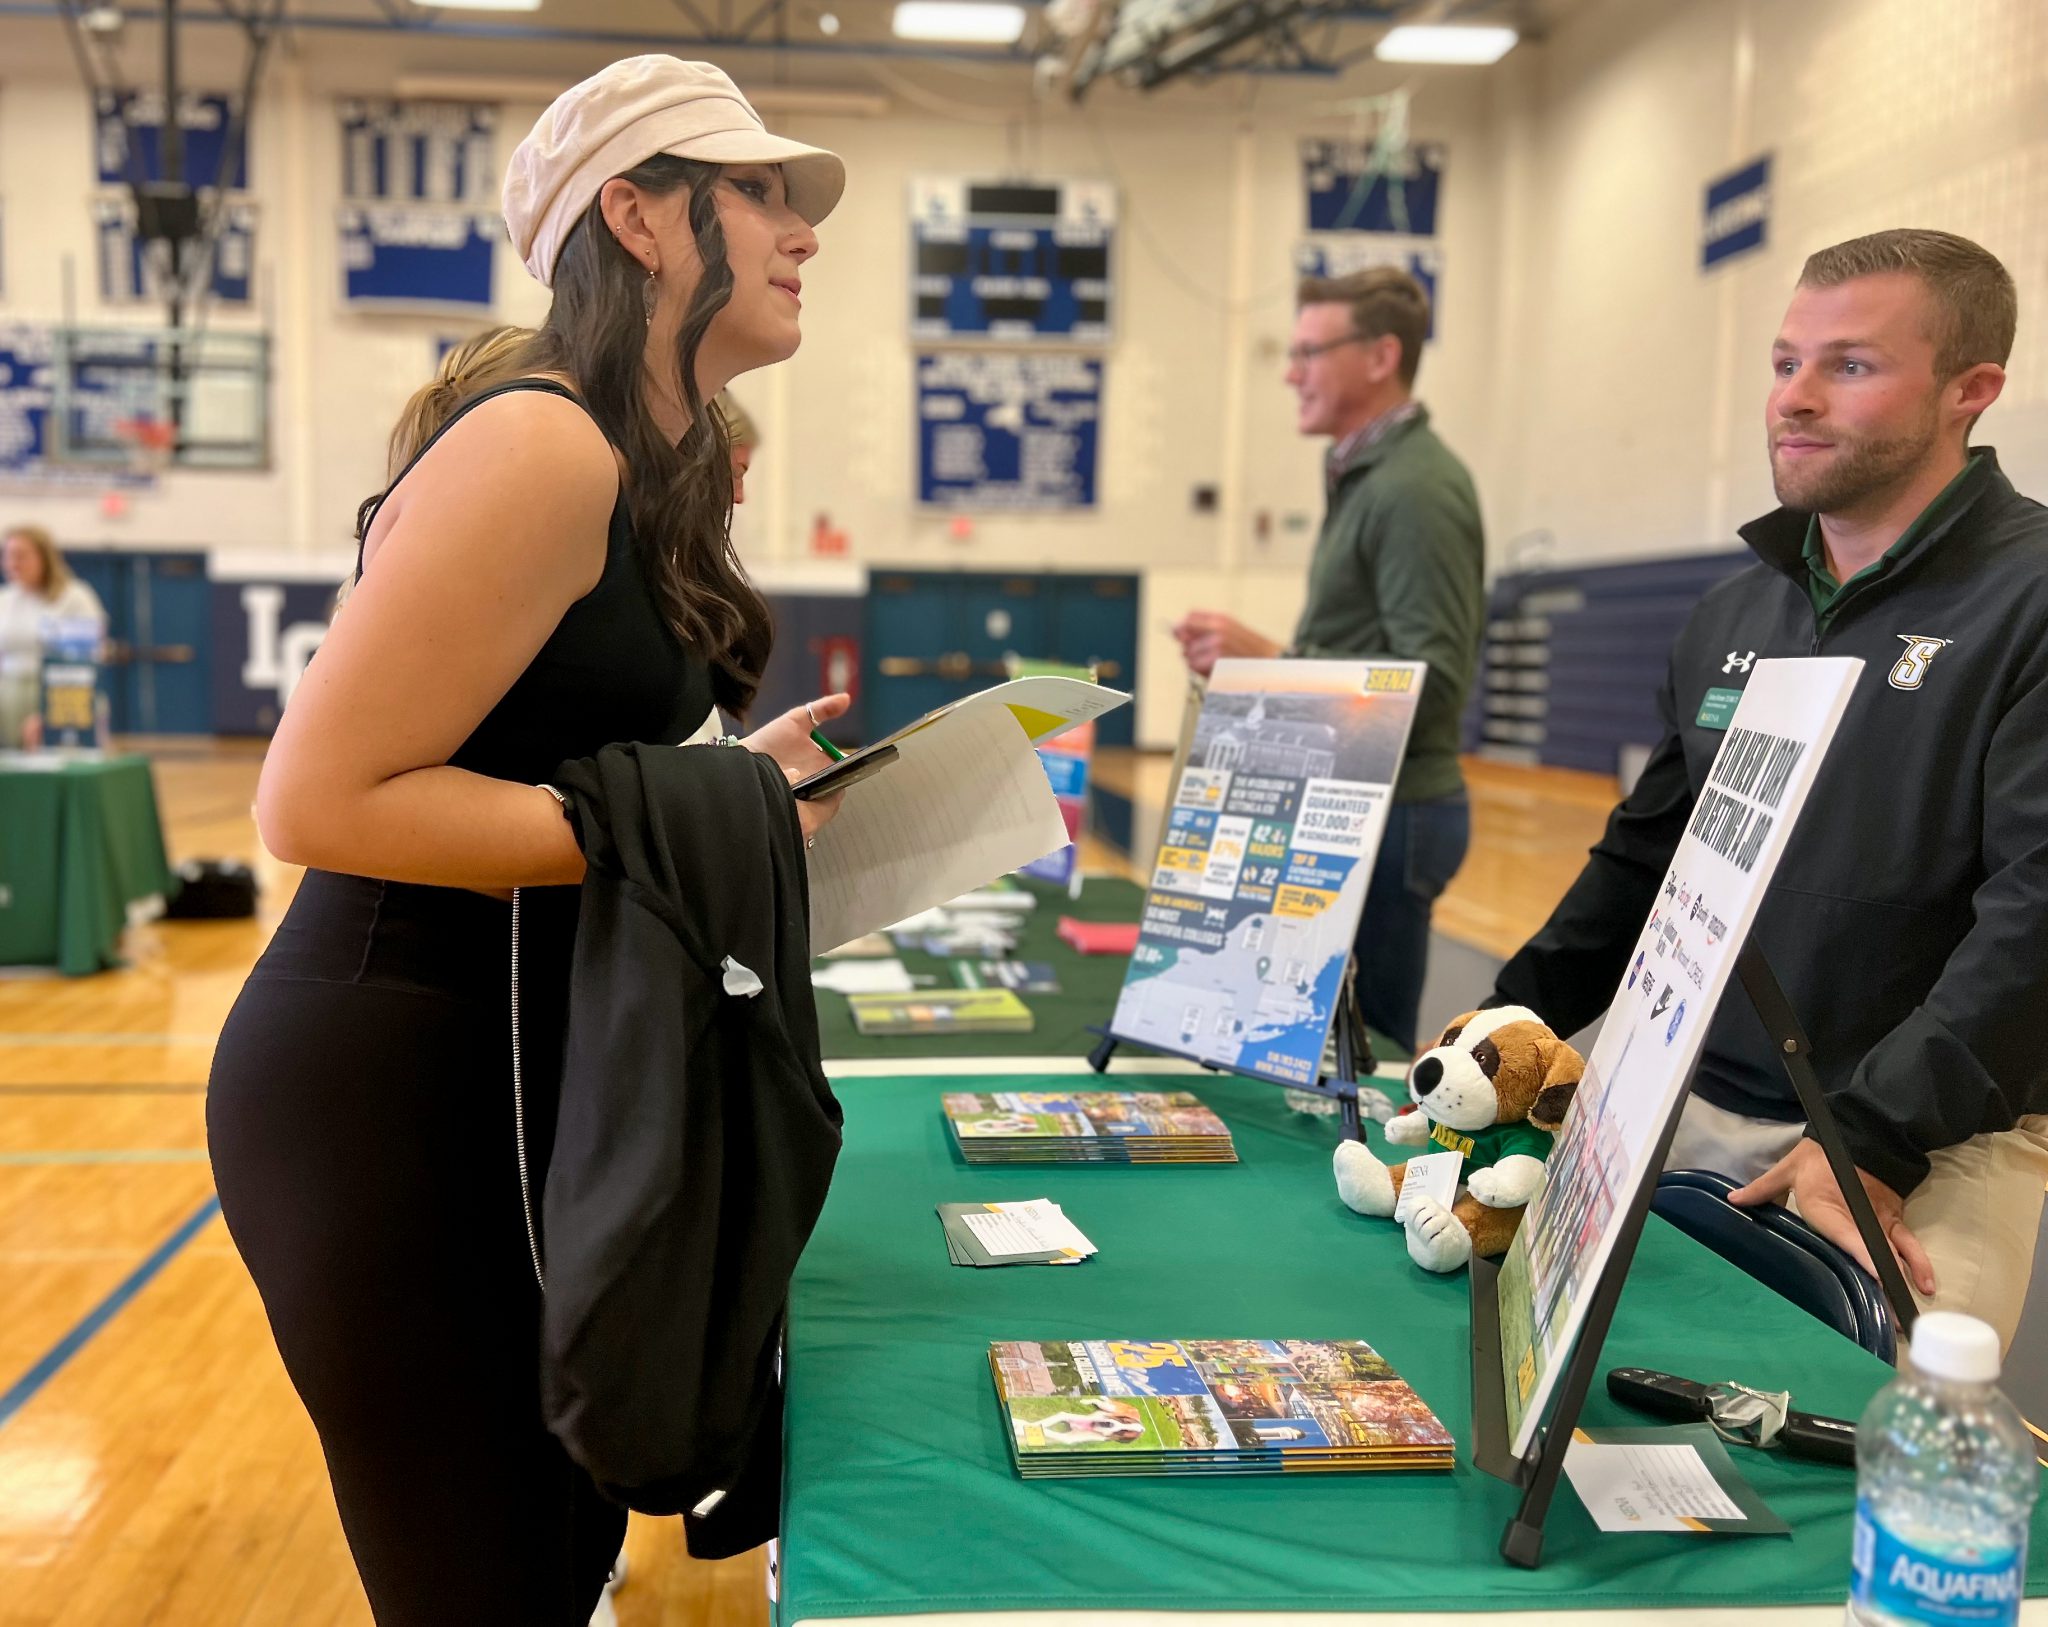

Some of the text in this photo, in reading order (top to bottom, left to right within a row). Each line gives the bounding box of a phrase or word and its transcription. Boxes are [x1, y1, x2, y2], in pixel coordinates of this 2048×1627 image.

[1366, 668, 1413, 691] SIENA
[1711, 727, 1806, 808] #1 IN NEW YORK
[1306, 795, 1371, 813] GUARANTEED
[1301, 810, 1351, 830] $57,000
[1689, 787, 1775, 873] FOR GETTING A JOB
[1252, 823, 1272, 842] 42
[1259, 865, 1280, 885] 22
[1107, 1342, 1187, 1368] 25
